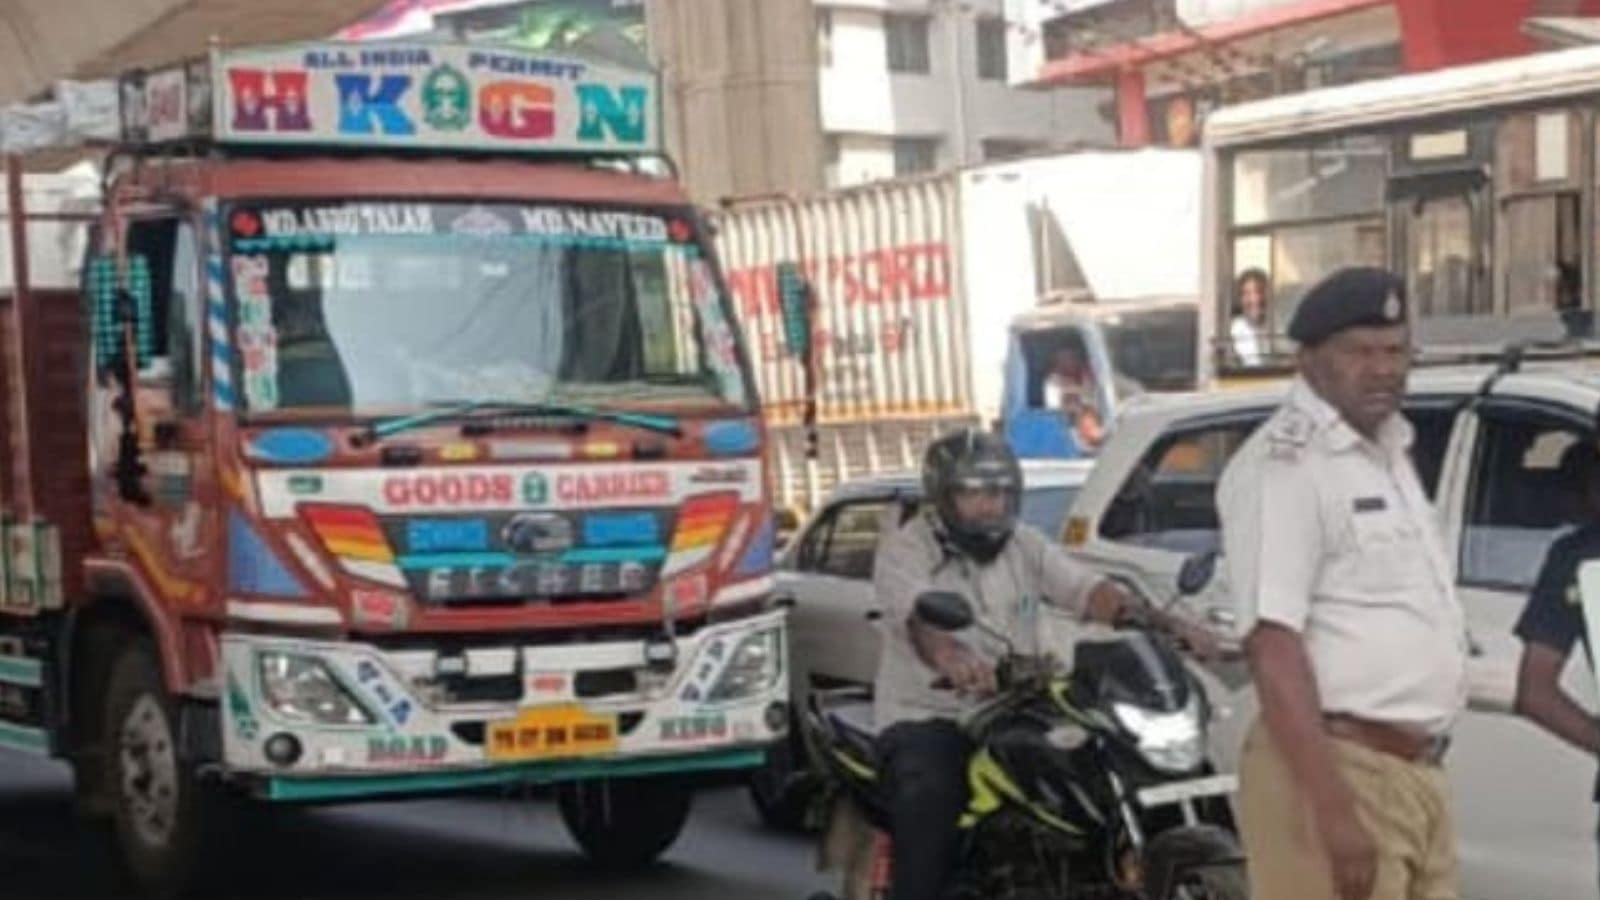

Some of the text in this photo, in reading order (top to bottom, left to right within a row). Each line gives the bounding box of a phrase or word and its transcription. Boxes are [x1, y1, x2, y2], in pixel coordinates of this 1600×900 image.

[304, 50, 586, 80] ALL INDIA PERMIT
[384, 474, 513, 506] GOODS
[659, 714, 728, 740] KING
[367, 734, 449, 763] ROAD
